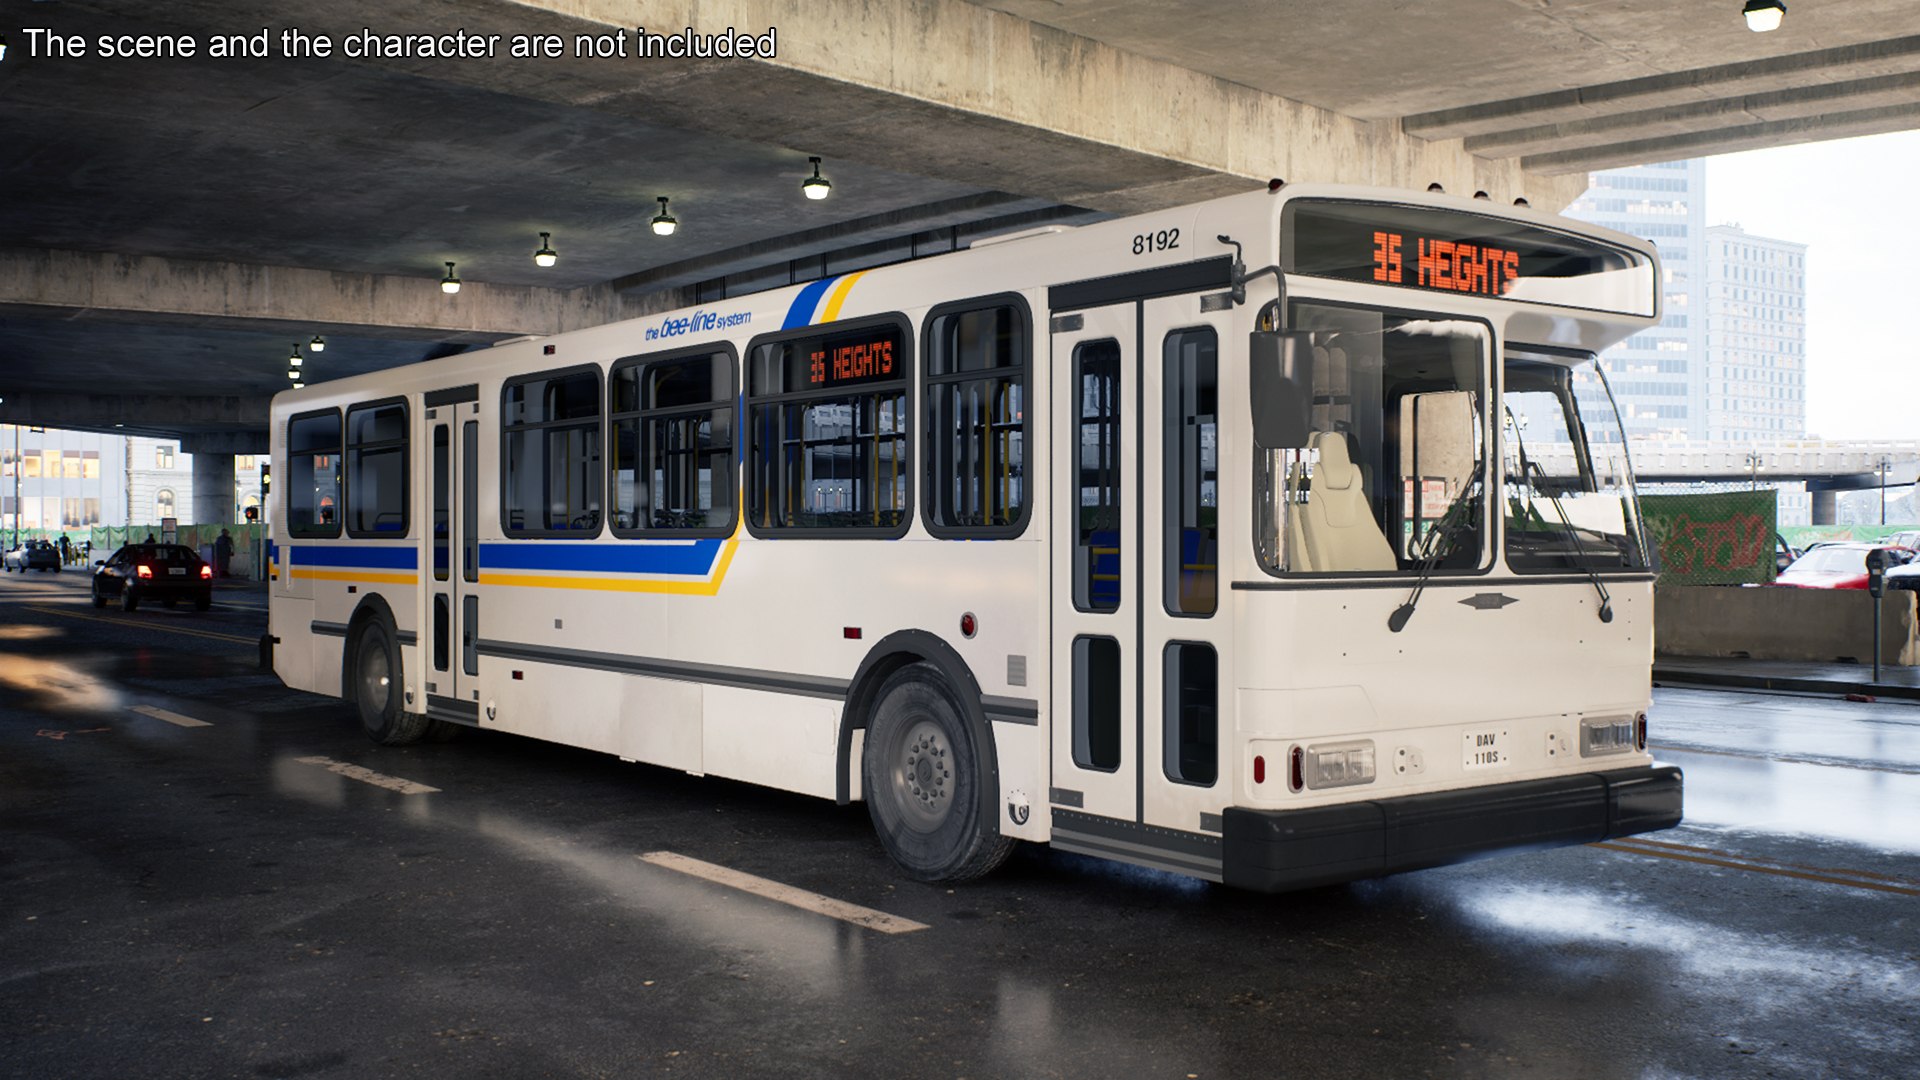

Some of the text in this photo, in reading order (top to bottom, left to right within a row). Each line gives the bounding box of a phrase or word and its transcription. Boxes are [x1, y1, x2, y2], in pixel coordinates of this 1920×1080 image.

[1132, 228, 1180, 255] 8192
[1374, 231, 1519, 296] 35 HEIGHTS
[645, 310, 752, 341] the bee-line system
[811, 341, 893, 383] 35 HEIGHTS
[1476, 733, 1496, 747] DAV
